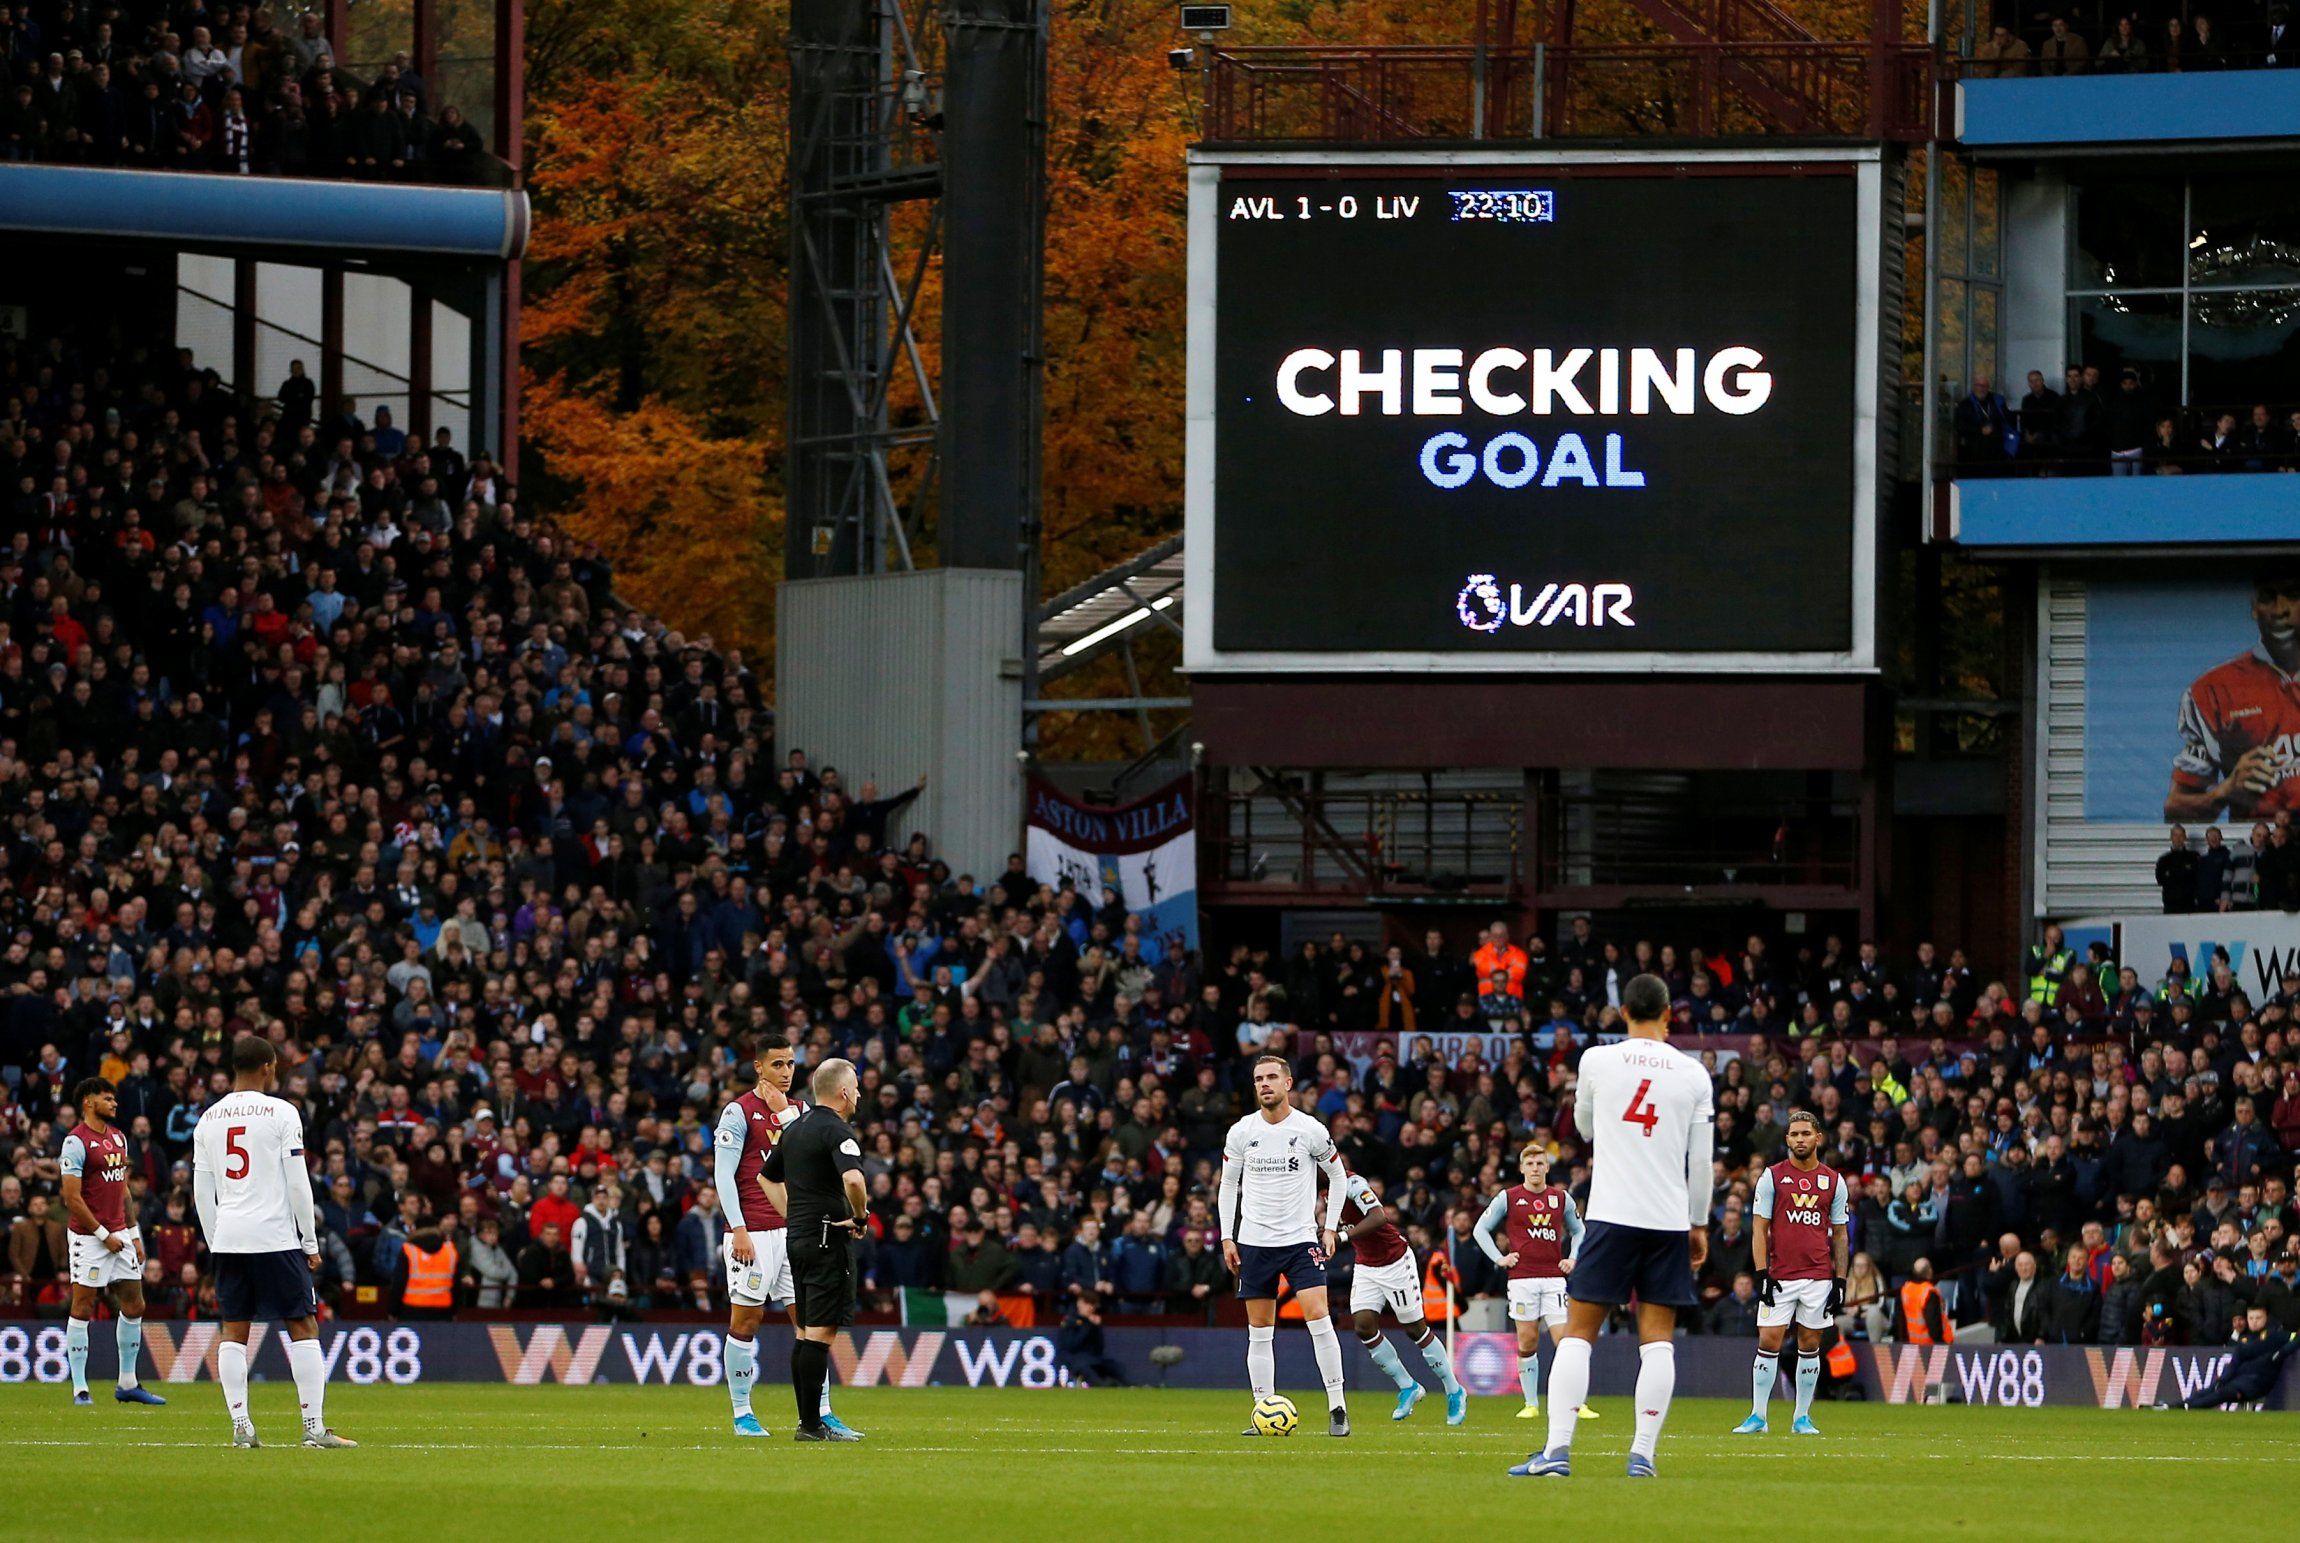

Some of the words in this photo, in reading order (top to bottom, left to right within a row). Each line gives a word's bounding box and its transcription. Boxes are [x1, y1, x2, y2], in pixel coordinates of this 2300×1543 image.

[1230, 197, 1284, 219] AVL
[1377, 196, 1420, 219] LIV
[1460, 193, 1542, 219] 22:10
[1276, 346, 1773, 416] CHECKING
[1419, 431, 1647, 489] GOAL
[1510, 583, 1636, 627] VAR
[1035, 791, 1107, 842] ASTON
[1114, 792, 1189, 841] VILLA
[1622, 1053, 1674, 1070] VIRGIL
[205, 1105, 274, 1121] WIJNALDUM
[1622, 1078, 1658, 1137] 4
[225, 1126, 250, 1180] 5
[1249, 1156, 1286, 1164] Standard
[1527, 1228, 1556, 1241] W88
[1786, 1210, 1821, 1226] W88
[1393, 1290, 1407, 1306] 11
[621, 1331, 759, 1386] W8
[955, 1335, 1068, 1388] W8
[1955, 1349, 2045, 1407] W88
